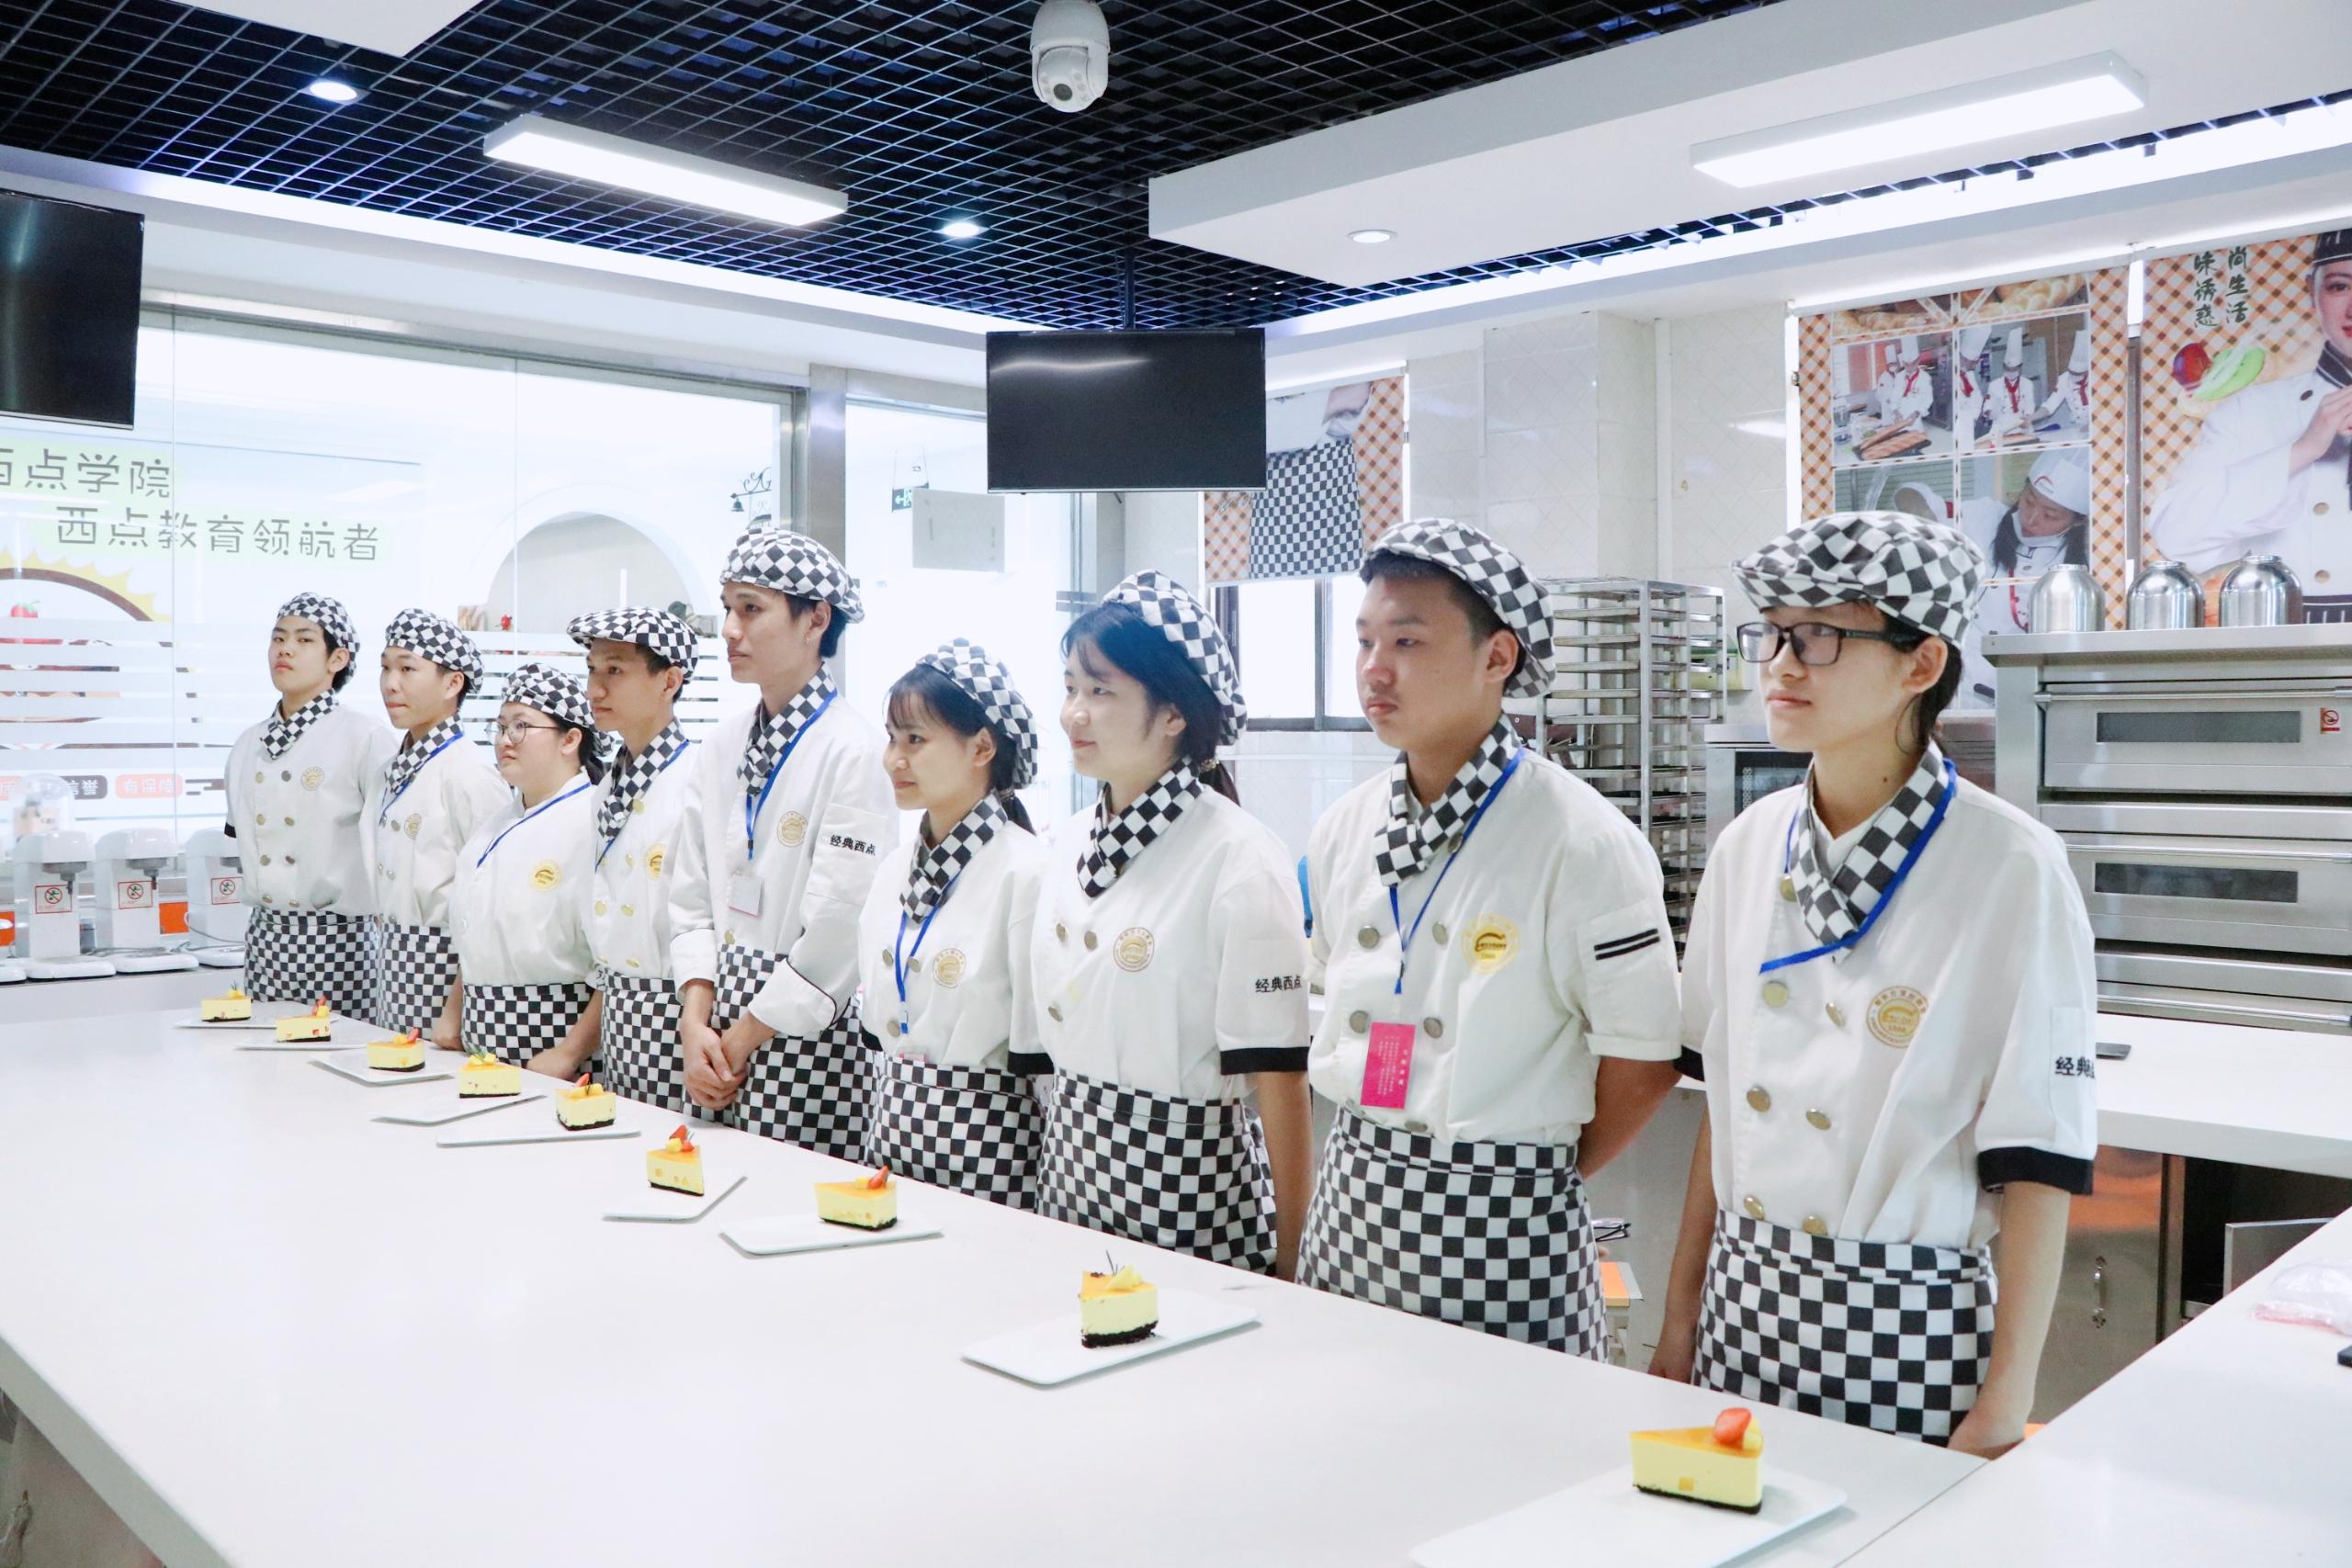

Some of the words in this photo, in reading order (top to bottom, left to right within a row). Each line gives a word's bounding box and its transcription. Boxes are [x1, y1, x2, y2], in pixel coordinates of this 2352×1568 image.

[2225, 245, 2249, 324] 尚生活
[57, 506, 378, 560] 西点教育领航者
[830, 834, 876, 856] 经典西点
[1255, 975, 1302, 993] 经典西点
[2054, 1055, 2095, 1078] 经典
